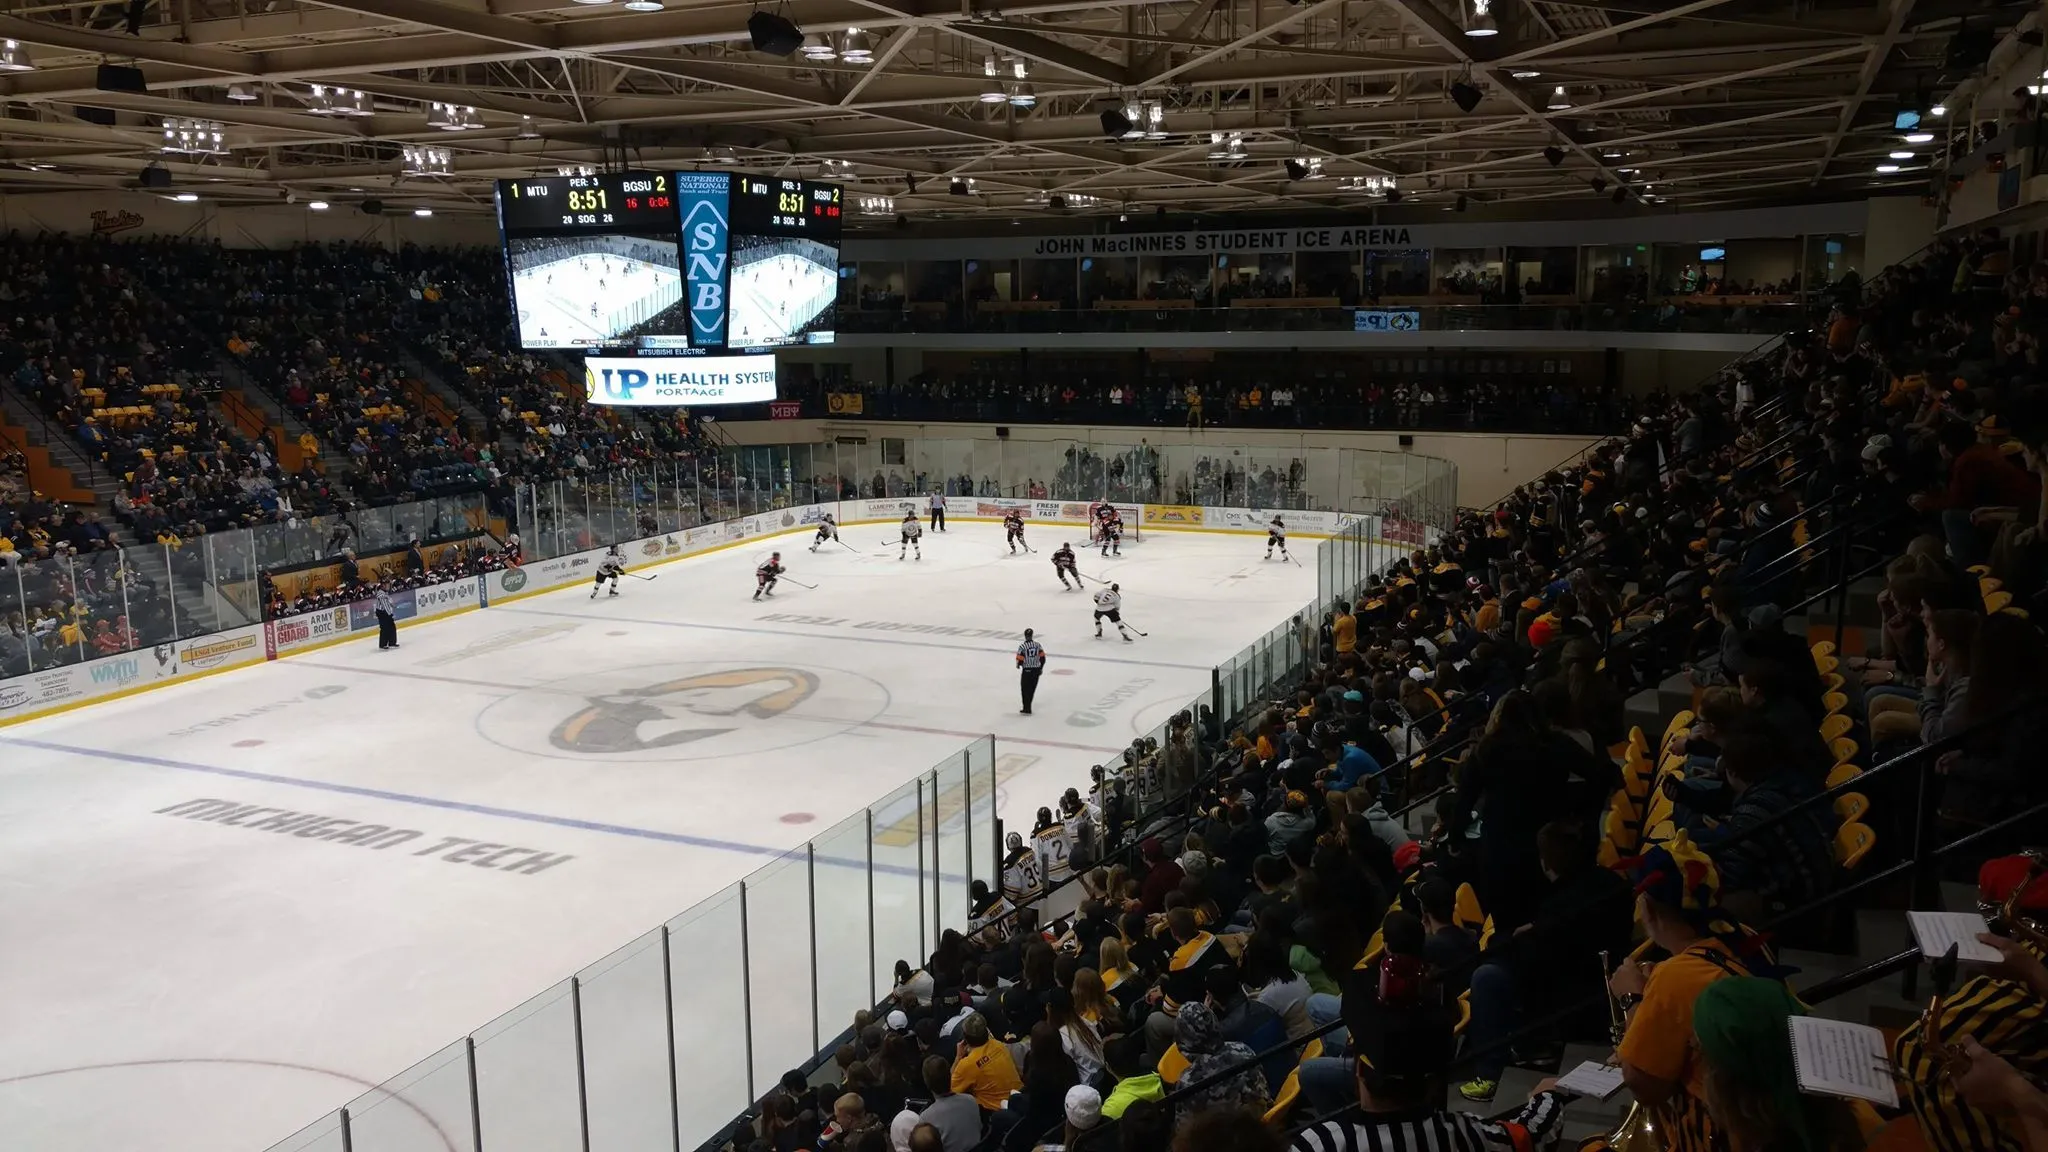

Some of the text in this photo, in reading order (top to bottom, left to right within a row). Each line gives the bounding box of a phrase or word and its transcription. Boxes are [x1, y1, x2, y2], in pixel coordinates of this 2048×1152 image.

[569, 177, 598, 188] PER: 3
[655, 176, 666, 192] 2
[680, 175, 729, 183] SUPERIOR
[741, 178, 747, 193] 1
[511, 183, 519, 198] 1
[526, 185, 548, 197] MTU
[623, 181, 651, 192] BGSU
[752, 183, 768, 194] MTU
[568, 189, 607, 210] 8:51
[814, 189, 831, 201] BGSU
[832, 188, 839, 202] 2
[779, 192, 804, 213] 8:51
[578, 214, 595, 224] SOG
[1035, 228, 1411, 255] JOHN MacINNES STUDENT ICE ARENA
[601, 369, 649, 399] UP
[735, 371, 775, 385] SYSTEM
[310, 612, 333, 625] ARMY
[313, 622, 332, 634] ROTC
[277, 626, 309, 645] GUARD
[89, 659, 139, 683] WMTU
[152, 798, 578, 876] MICHIGAN TECH
[1051, 838, 1068, 861] 2
